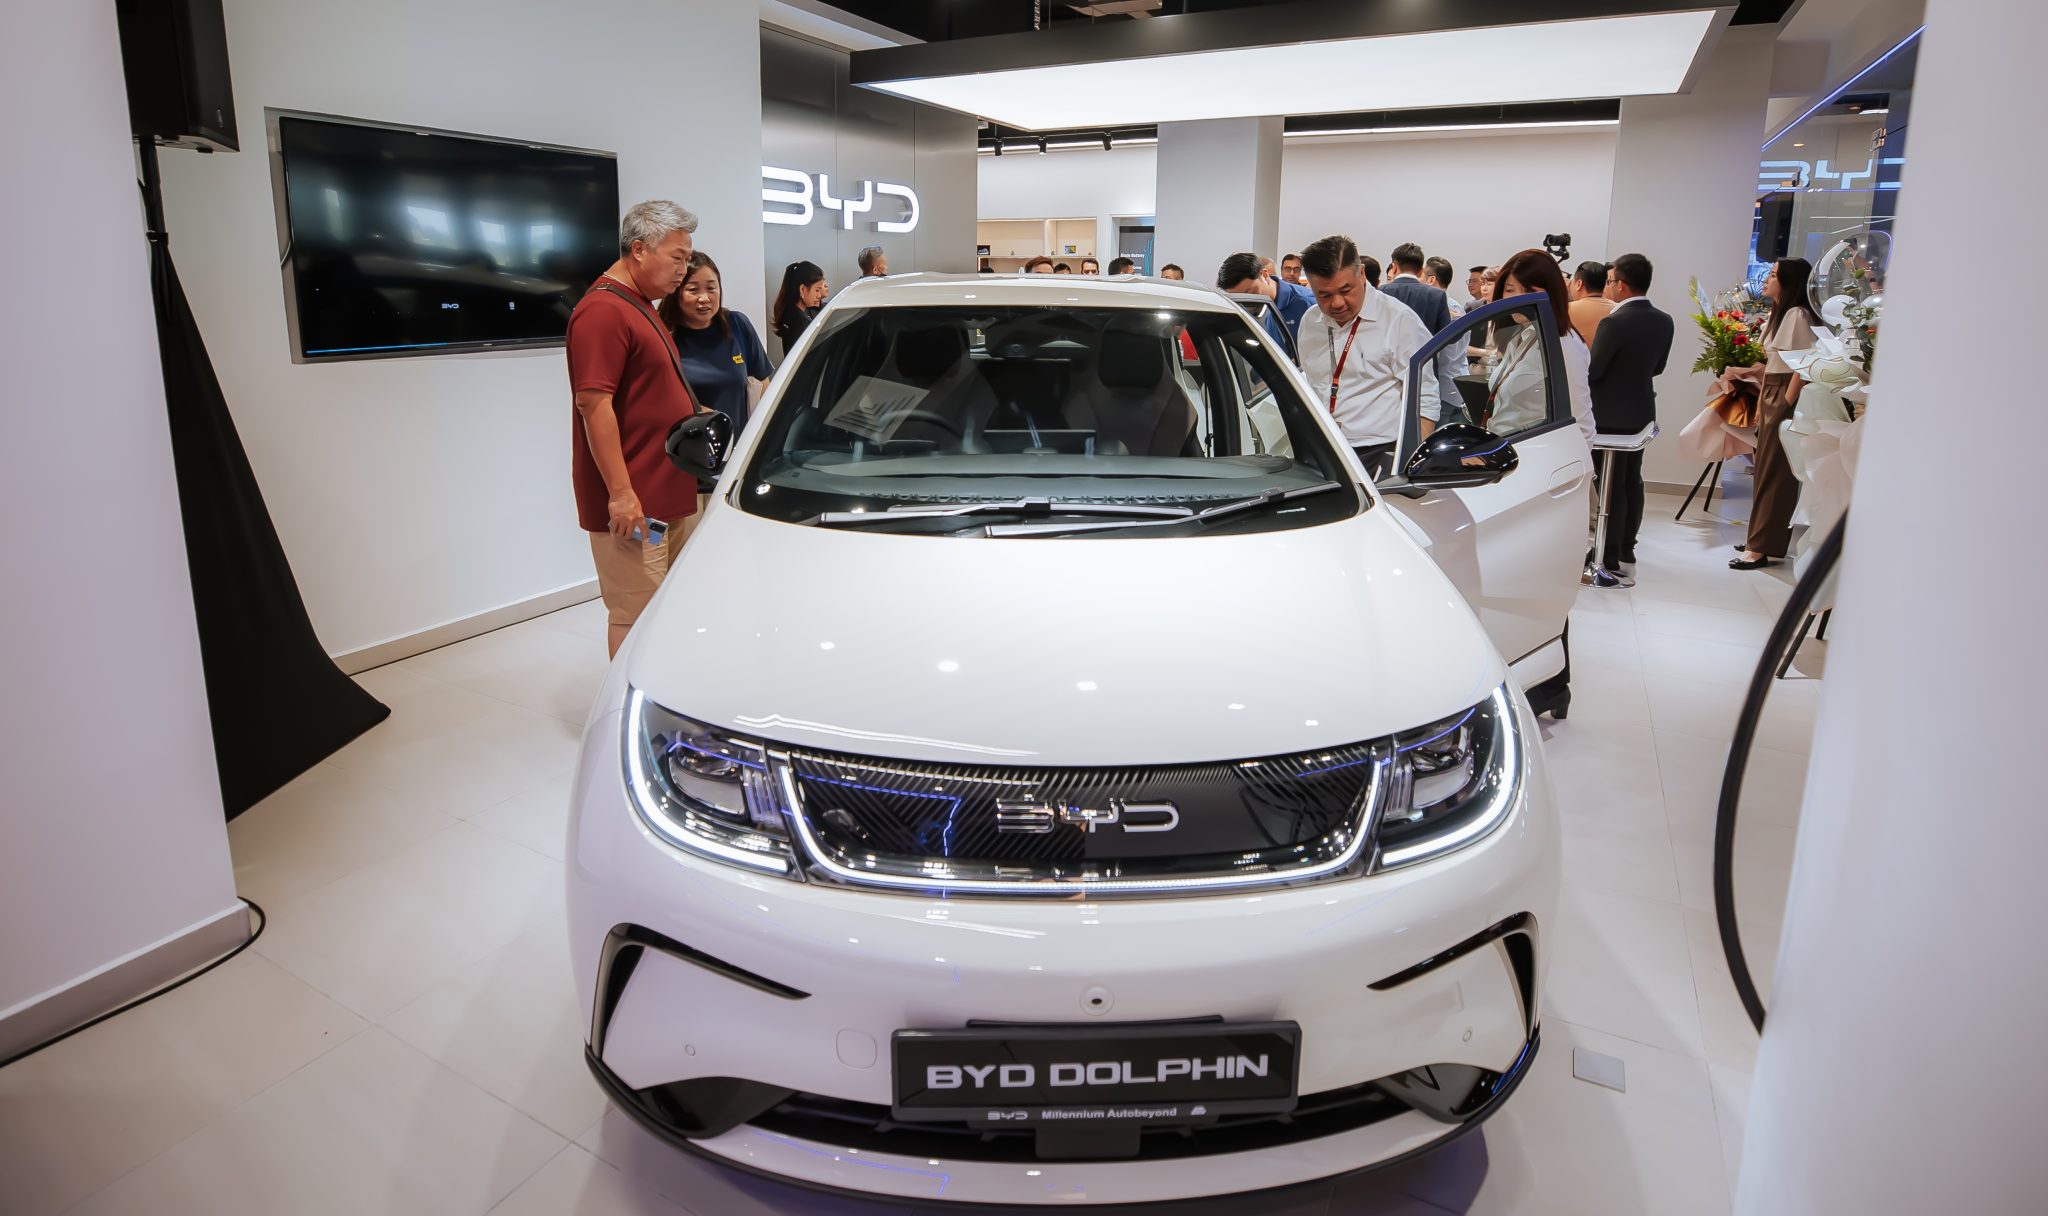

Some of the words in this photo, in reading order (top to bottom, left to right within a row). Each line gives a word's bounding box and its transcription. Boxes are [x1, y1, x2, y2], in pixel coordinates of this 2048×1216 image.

[761, 165, 920, 233] BYD
[996, 797, 1180, 833] BYD
[926, 1063, 1036, 1090] BYD
[1048, 1053, 1270, 1087] DOLPHIN
[987, 1110, 1029, 1121] BYD
[1041, 1109, 1105, 1121] Millennium
[1106, 1107, 1178, 1119] Autobeyond
